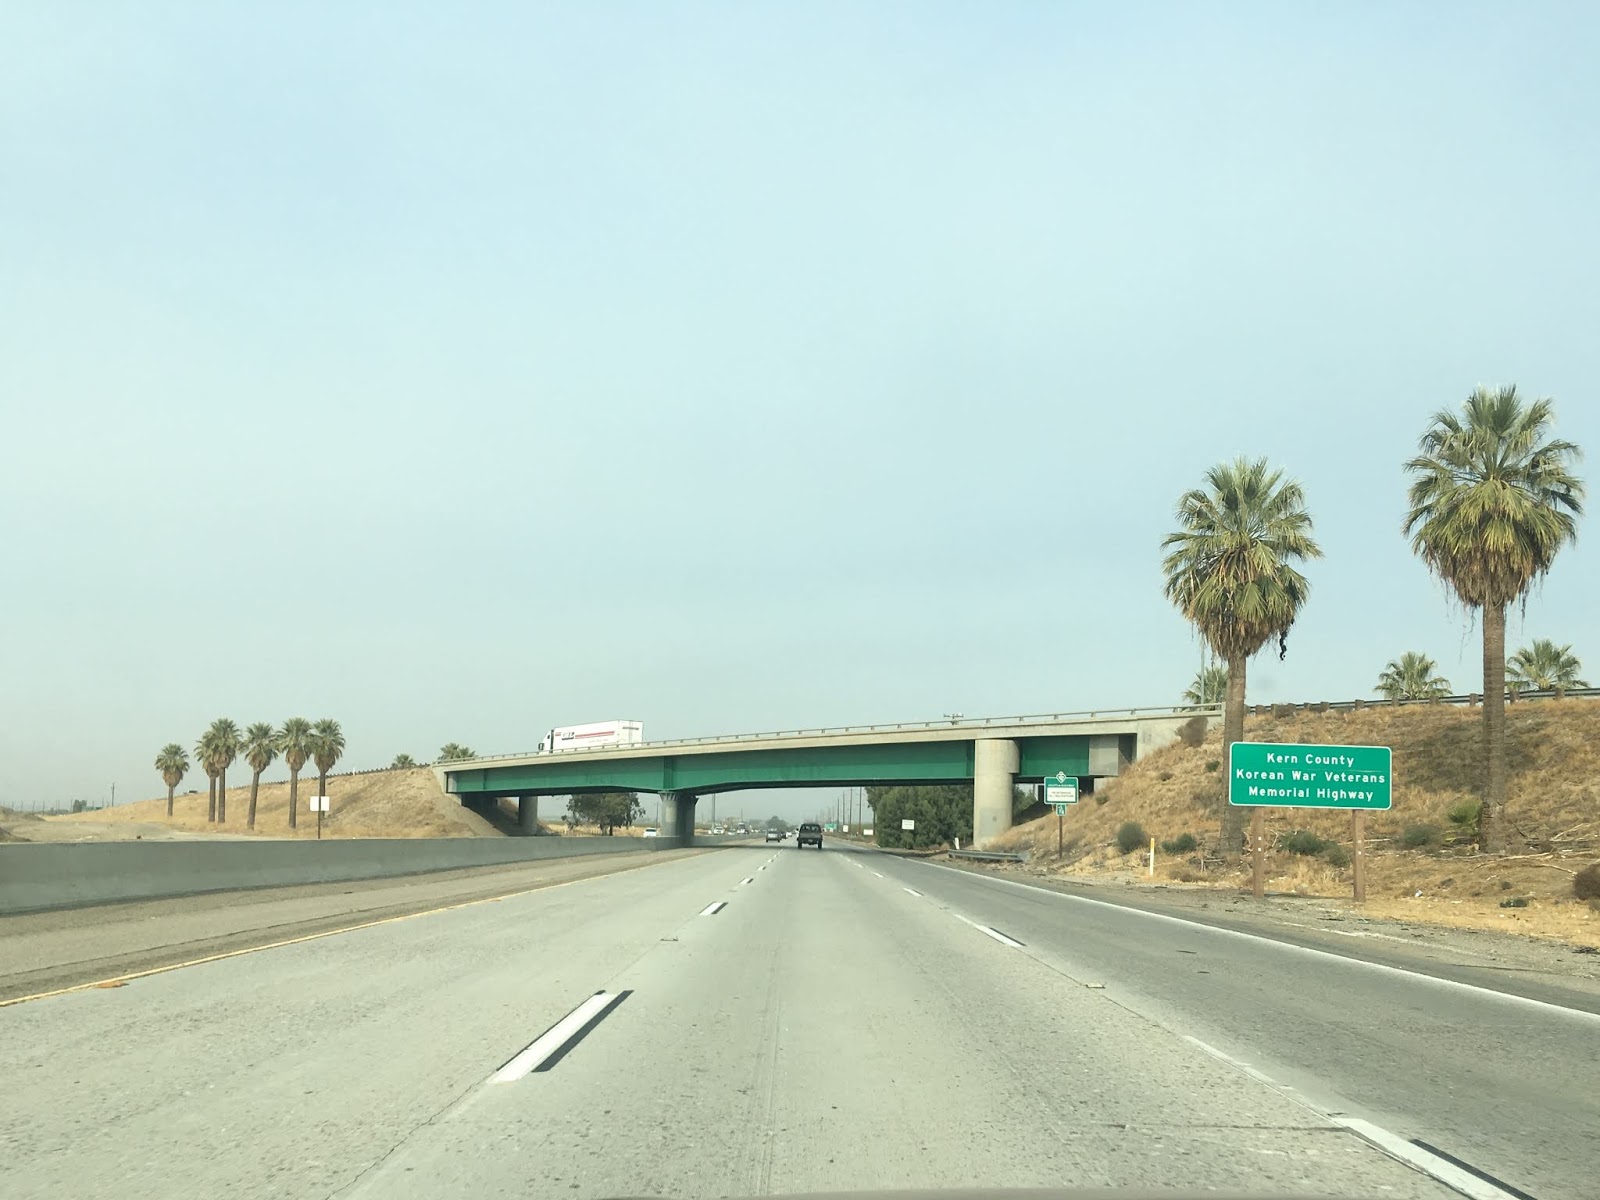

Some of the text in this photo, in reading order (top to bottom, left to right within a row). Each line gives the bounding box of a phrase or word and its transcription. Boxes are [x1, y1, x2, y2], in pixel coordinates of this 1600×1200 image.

[1266, 752, 1354, 768] Kern County
[1236, 768, 1385, 783] Korean War Veterans
[1248, 786, 1373, 802] Memorial Highway
